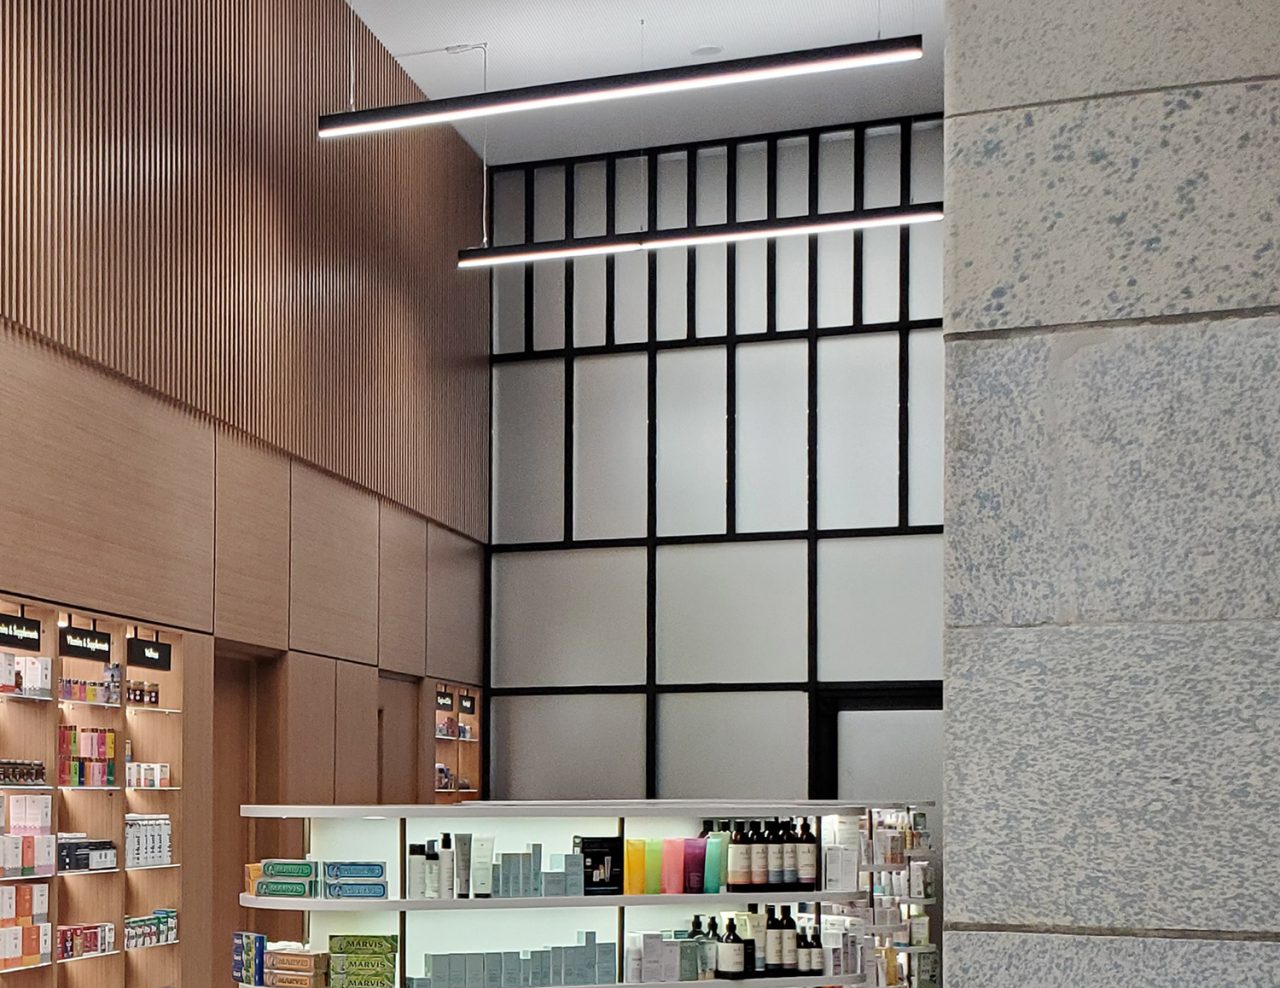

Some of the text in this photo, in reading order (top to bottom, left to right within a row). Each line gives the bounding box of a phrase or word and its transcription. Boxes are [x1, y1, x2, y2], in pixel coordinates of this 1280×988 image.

[347, 940, 383, 949] MARVIS
[349, 960, 386, 969] MARVIS
[277, 977, 308, 986] MARVIS
[349, 979, 385, 988] MARVIS
